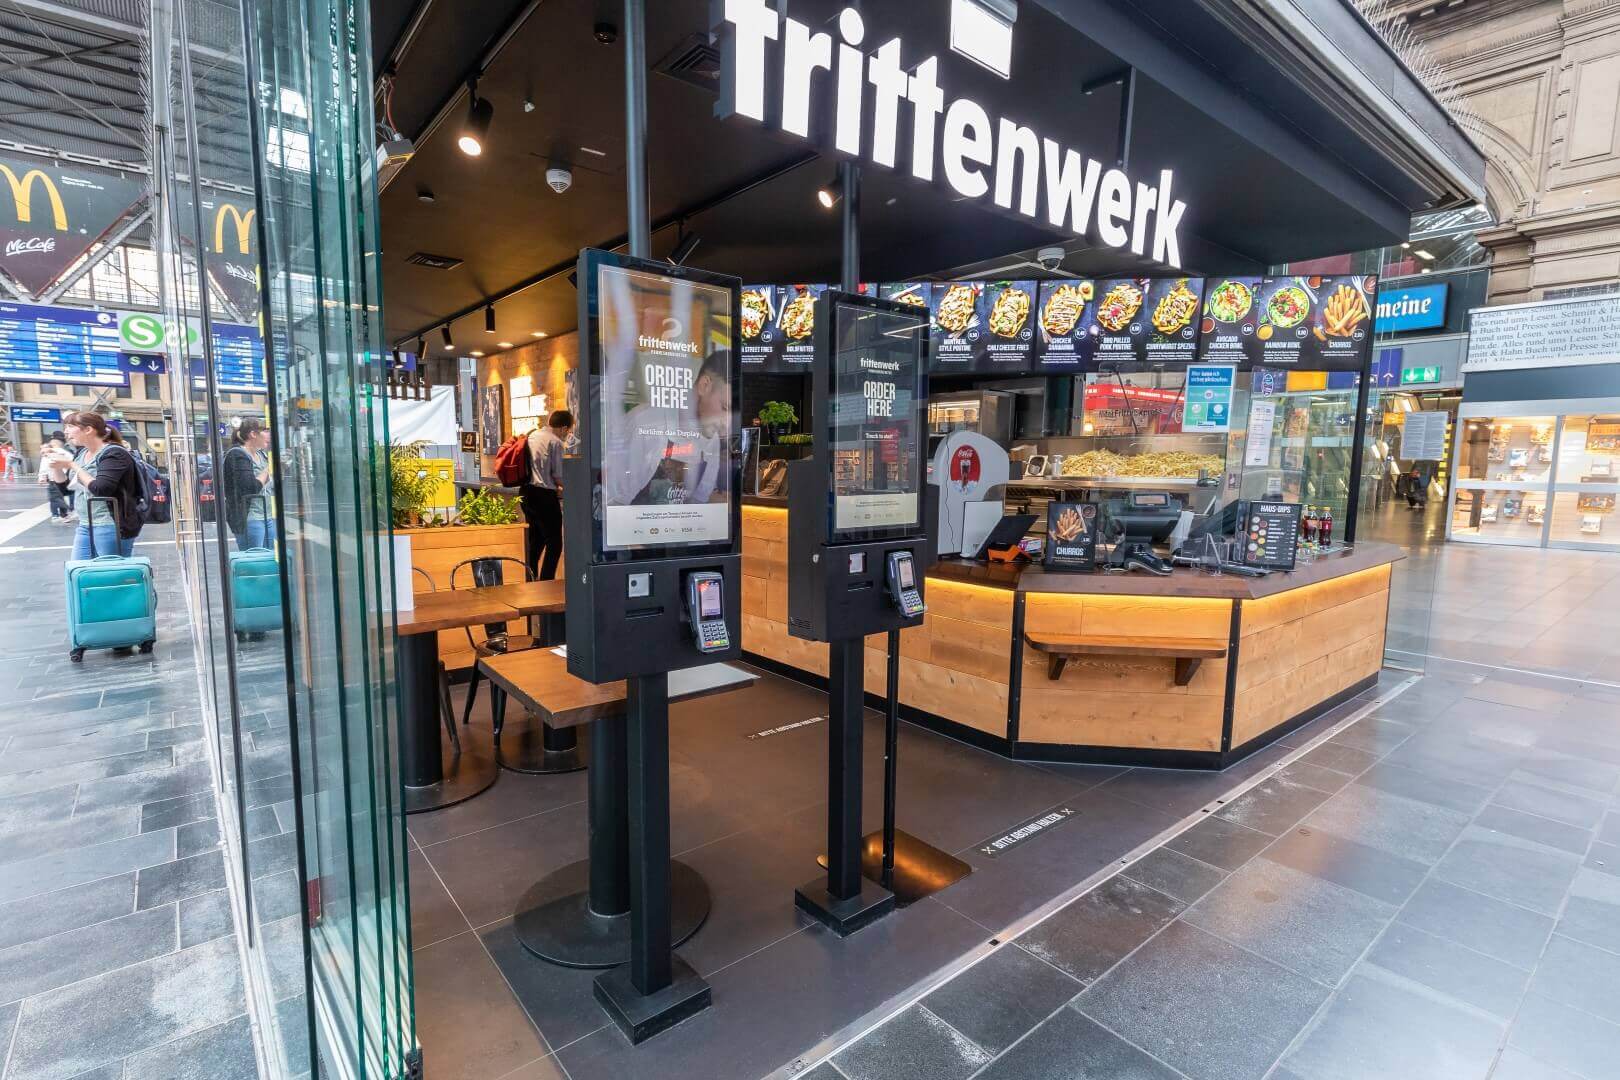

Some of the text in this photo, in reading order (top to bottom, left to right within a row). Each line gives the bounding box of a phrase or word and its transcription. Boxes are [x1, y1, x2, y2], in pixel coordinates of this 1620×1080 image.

[722, 0, 1188, 269] frittenwerk
[6, 237, 56, 256] McCafé
[1376, 294, 1431, 318] meine
[128, 323, 156, 348] S
[638, 334, 699, 354] frittenwerk
[860, 357, 900, 371] frittenwerk
[645, 364, 693, 389] ORDER
[650, 386, 689, 410] HERE
[863, 380, 896, 401] ORDER
[867, 398, 893, 417] HERE
[1056, 547, 1084, 556] CHURROS
[992, 834, 1017, 849] BITTE
